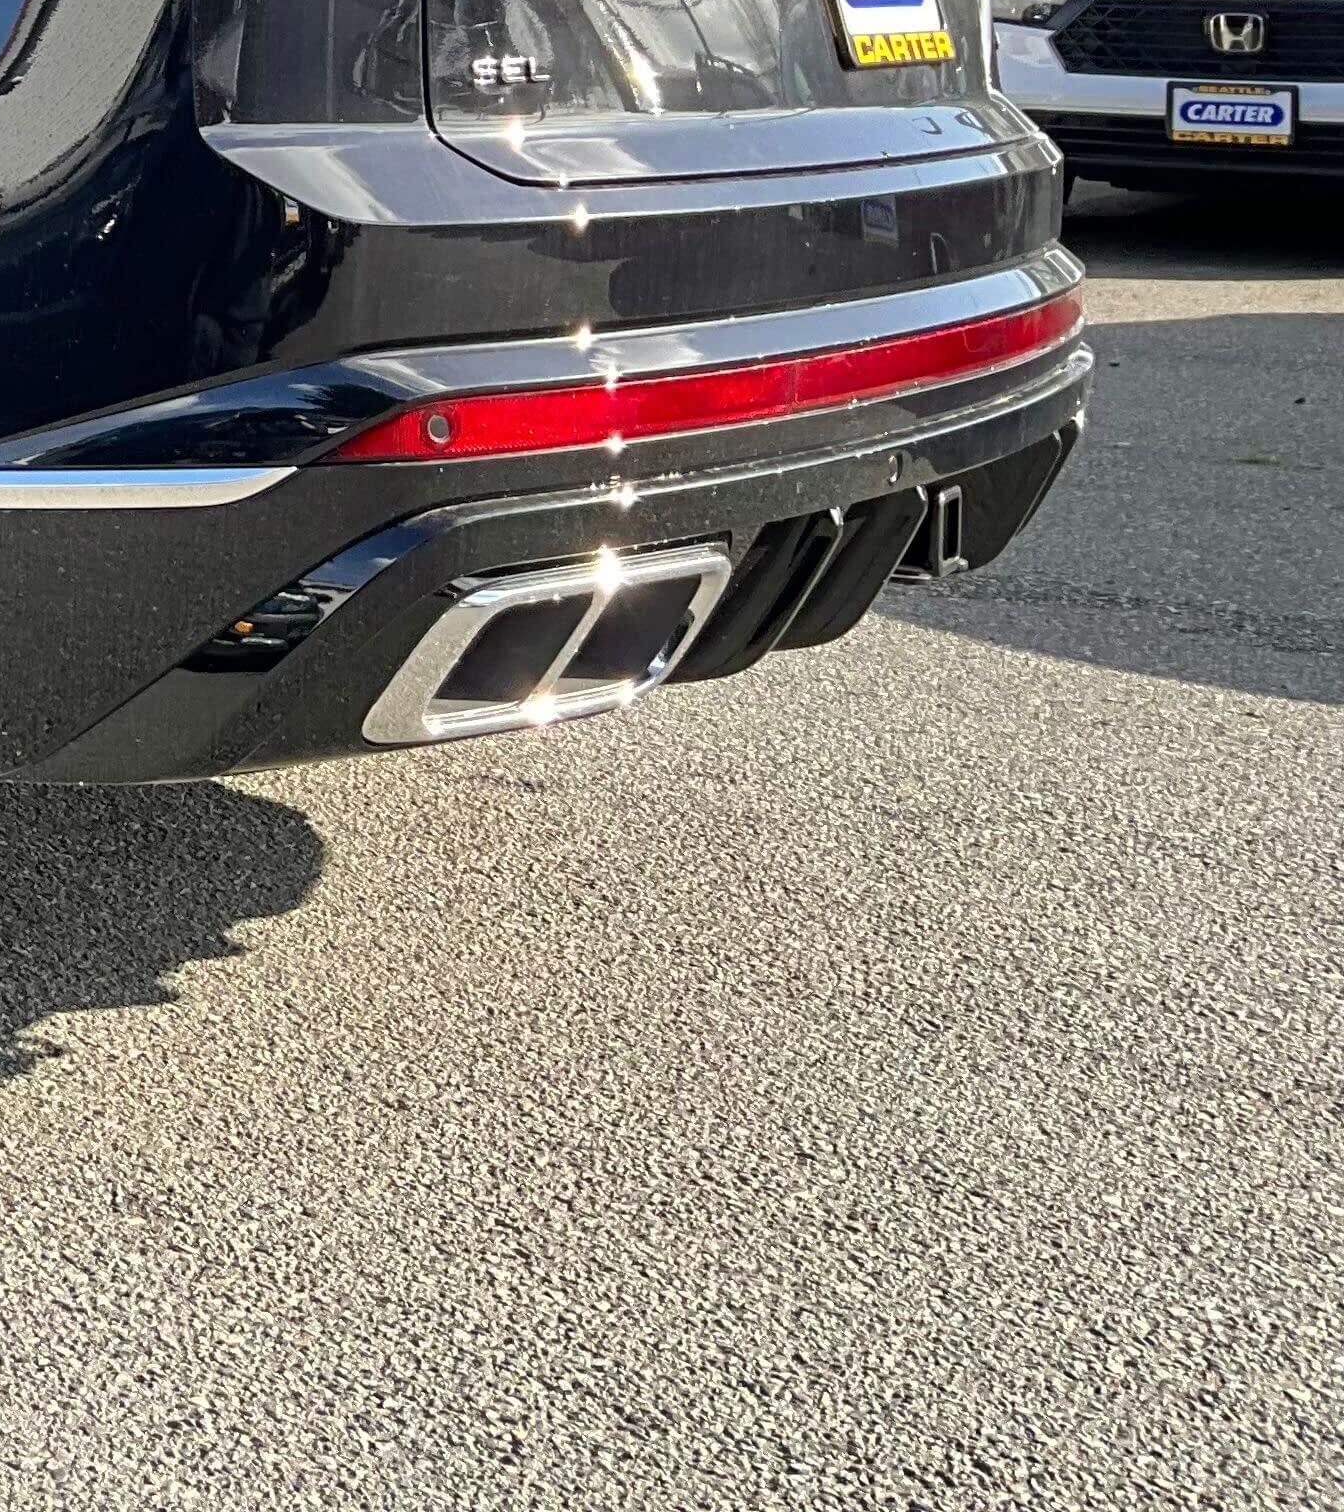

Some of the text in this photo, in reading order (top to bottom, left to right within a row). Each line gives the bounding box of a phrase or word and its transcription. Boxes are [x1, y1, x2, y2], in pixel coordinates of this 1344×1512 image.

[853, 31, 955, 63] CARTER
[473, 56, 550, 83] SEL
[1187, 104, 1274, 123] CARTER
[1173, 130, 1289, 145] CARTER
